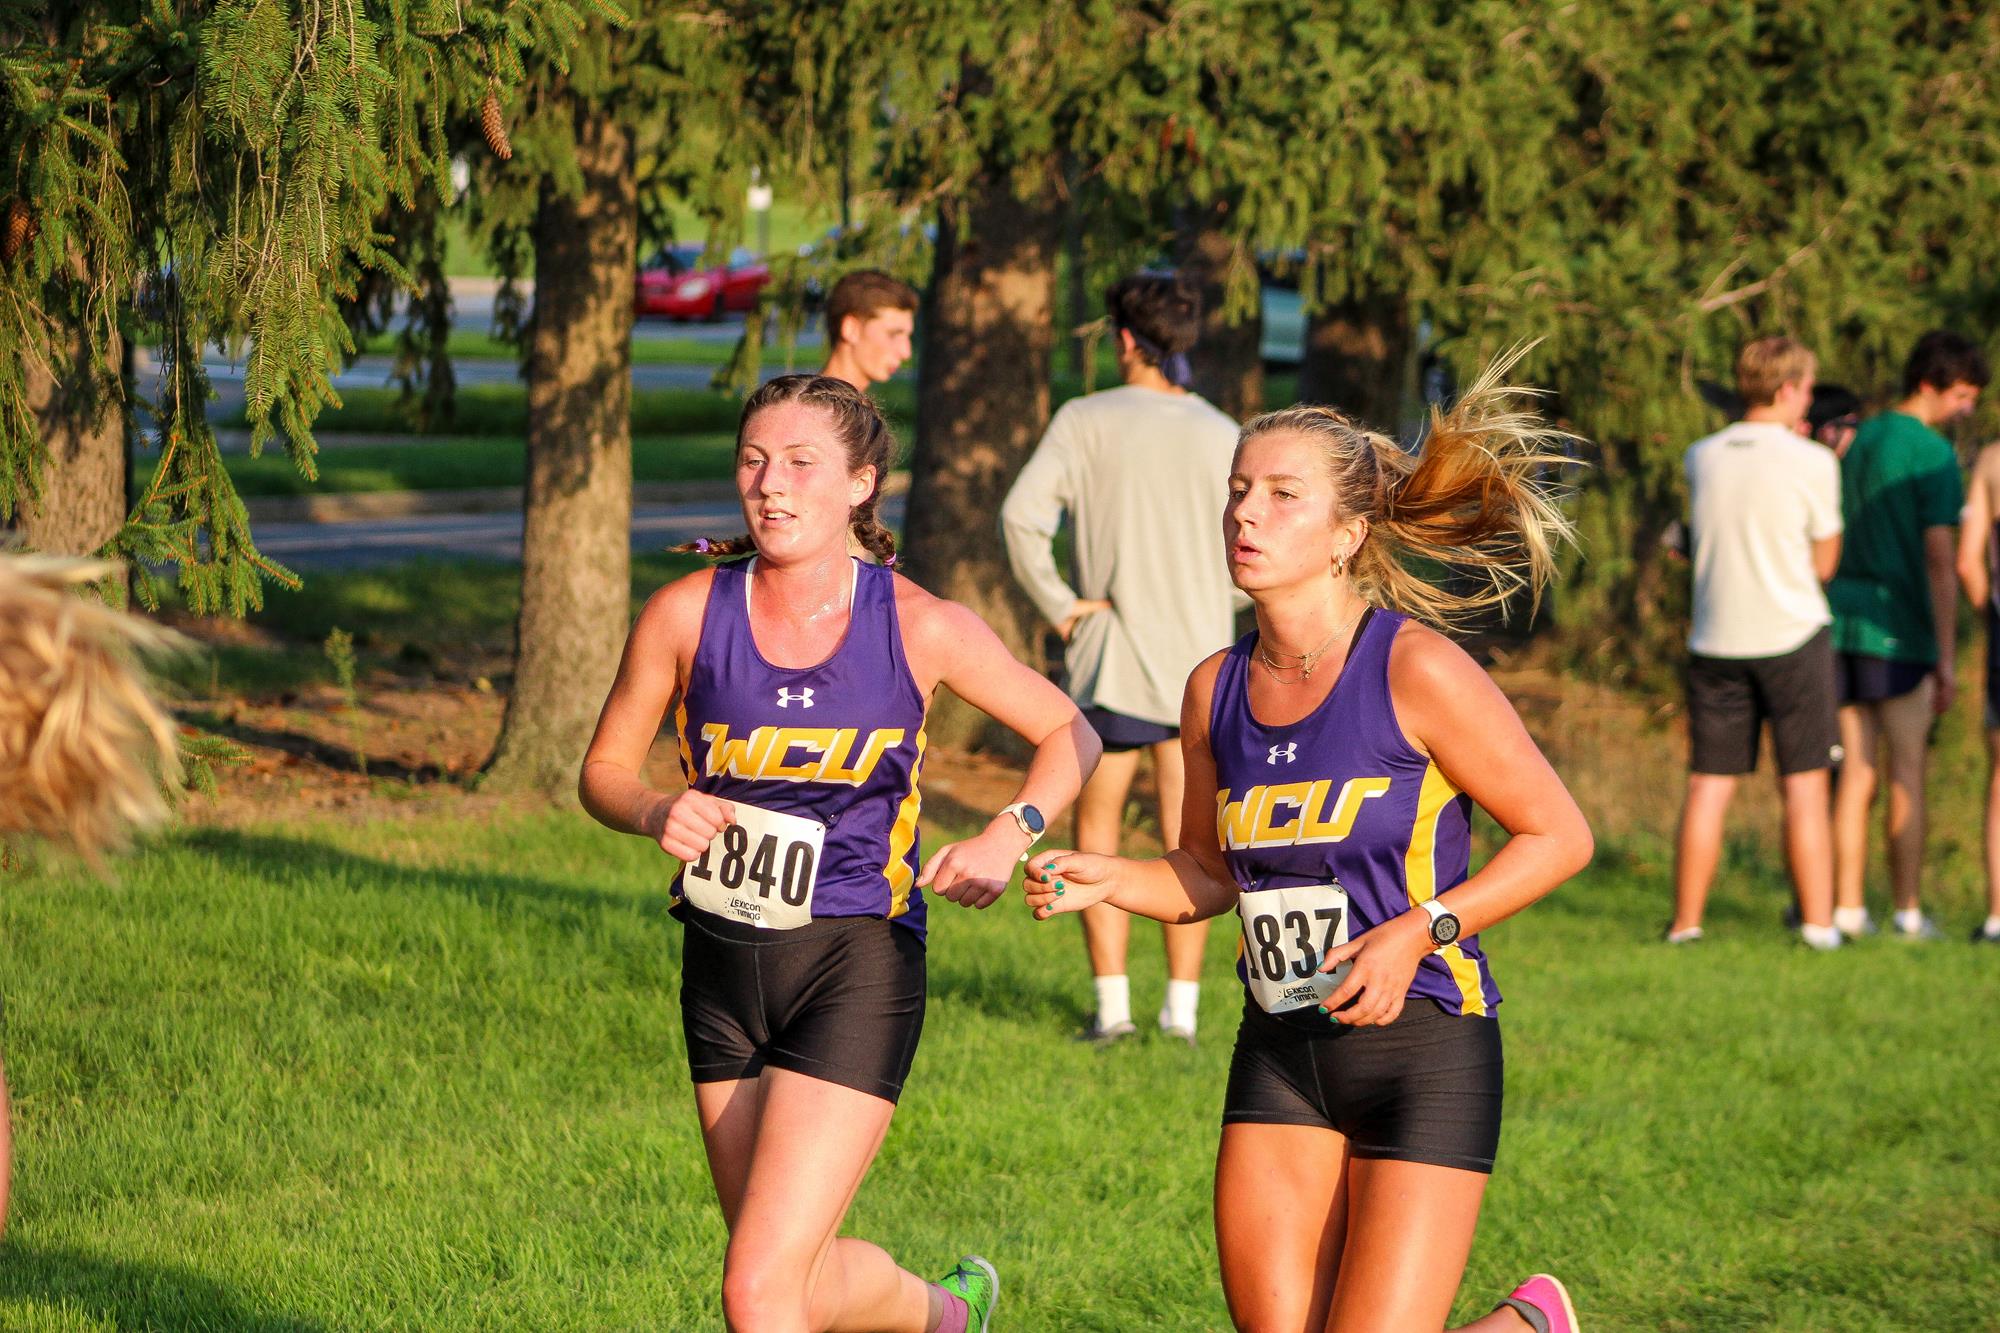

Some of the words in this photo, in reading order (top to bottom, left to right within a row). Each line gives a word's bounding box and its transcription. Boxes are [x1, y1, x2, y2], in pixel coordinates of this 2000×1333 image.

[701, 722, 905, 788] WCU
[1216, 777, 1391, 852] WCU
[690, 824, 815, 907] 1840
[1241, 907, 1342, 982] 1837
